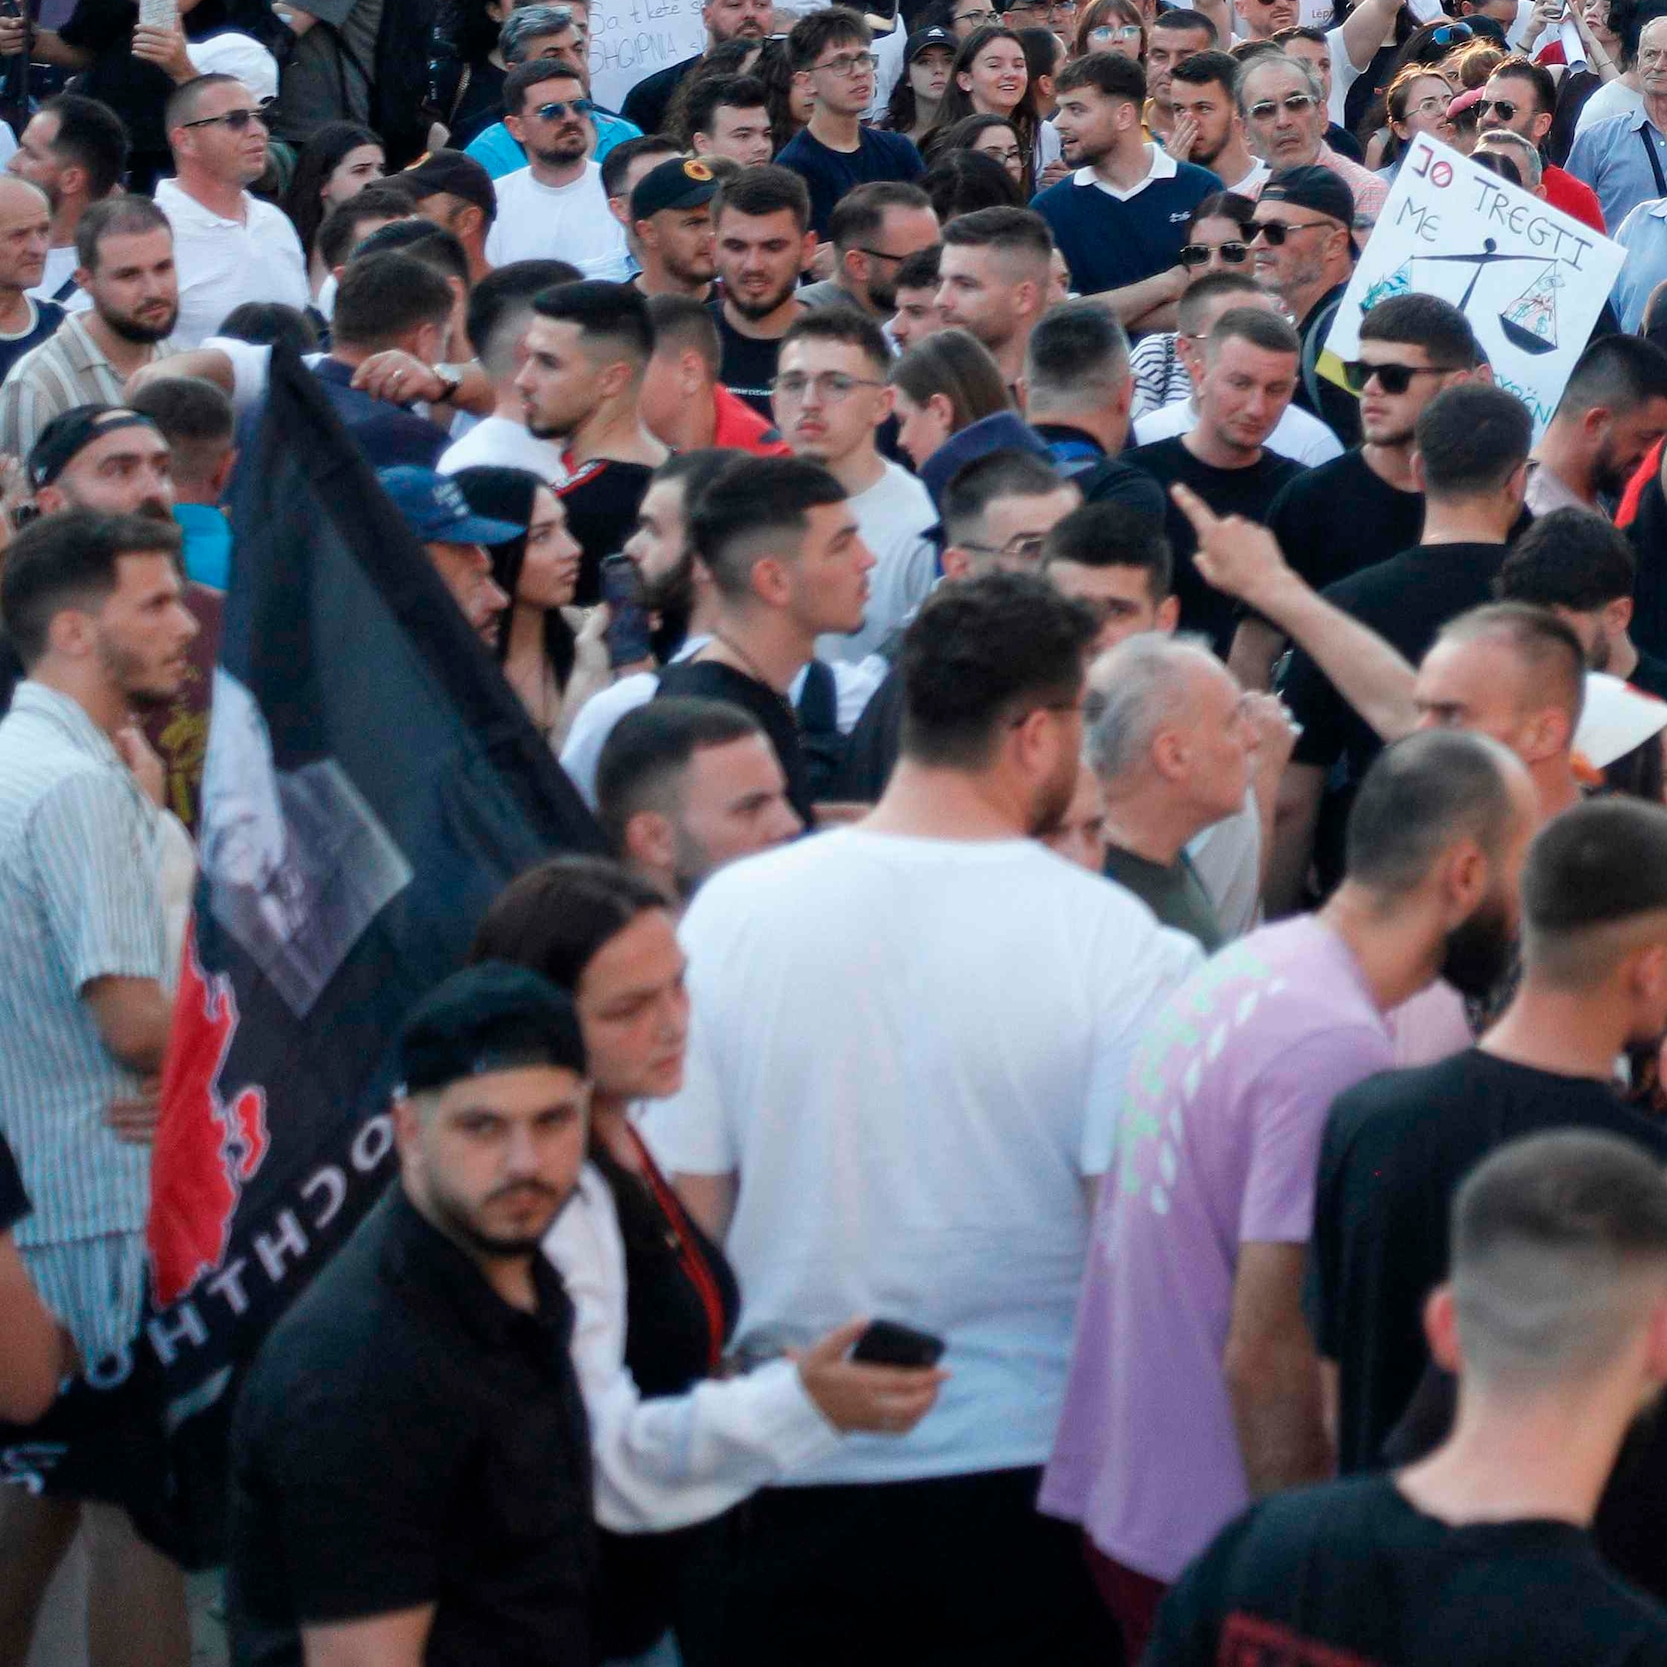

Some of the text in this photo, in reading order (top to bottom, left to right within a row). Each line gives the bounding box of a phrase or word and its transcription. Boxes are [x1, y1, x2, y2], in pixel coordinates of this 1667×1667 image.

[1396, 196, 1443, 243] ME
[1412, 143, 1593, 272] JO TREGTI
